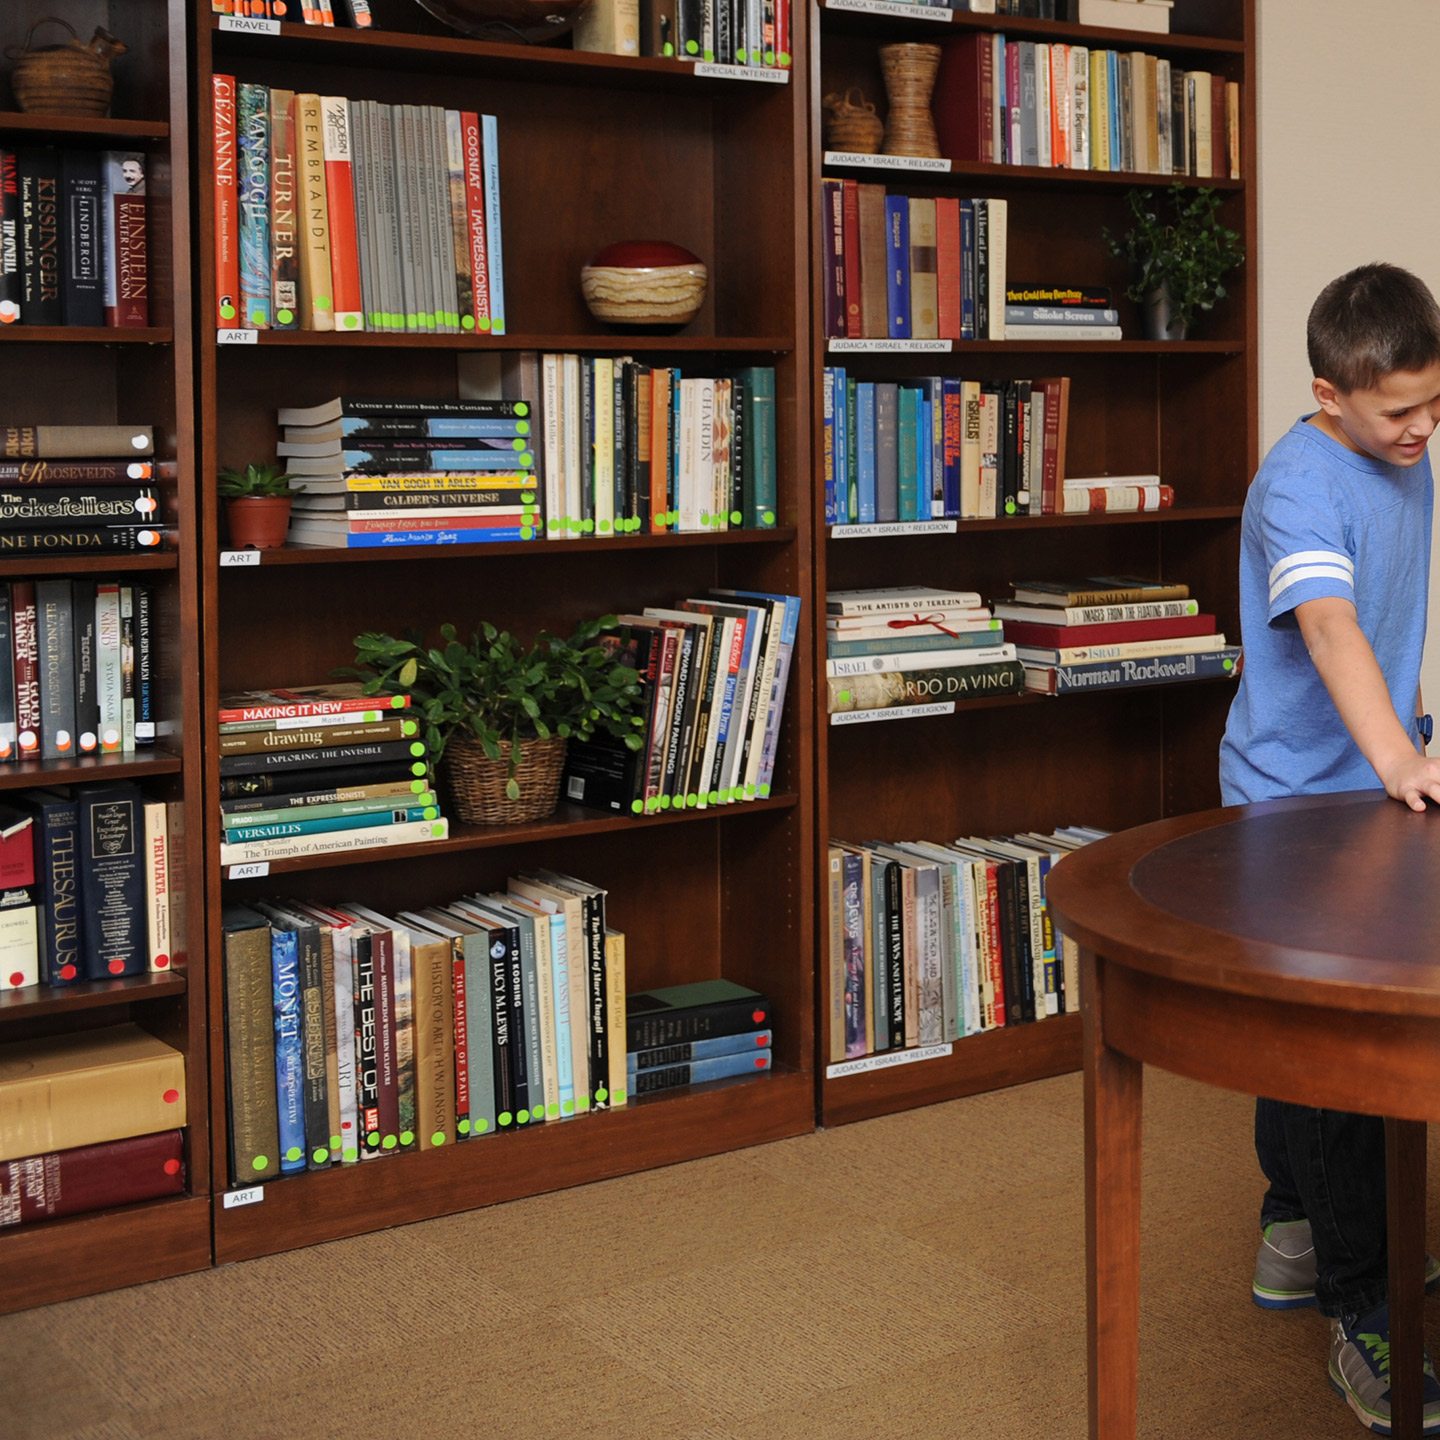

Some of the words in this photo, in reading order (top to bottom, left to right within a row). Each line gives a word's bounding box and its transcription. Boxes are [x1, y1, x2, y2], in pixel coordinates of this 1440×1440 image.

[228, 18, 272, 31] TRAVEL
[701, 65, 737, 77] SPECIAL
[740, 69, 782, 80] INTEREST
[214, 81, 233, 187] CÉZANNE
[249, 112, 269, 151] VAN
[336, 103, 348, 154] MODERN
[466, 125, 481, 190] COGNIAT
[831, 155, 866, 164] JUDAICA
[873, 157, 901, 167] ISRAEL
[908, 159, 946, 169] RELIGION
[249, 157, 269, 220] GOGH
[304, 108, 326, 253] REMBRANDT
[274, 154, 294, 261] TURNER
[118, 203, 130, 244] WALTER
[38, 178, 58, 301] KISSINGER
[79, 200, 91, 275] LINDBERGH
[128, 203, 147, 299] EINSTEIN
[120, 246, 131, 300] ISAACSON
[1033, 310, 1064, 320] Smoke
[1065, 311, 1095, 321] Screen
[226, 333, 249, 341] ART
[824, 373, 834, 419] Masada
[701, 387, 712, 462] CHARDIN
[734, 395, 742, 491] SUCCULENTS
[379, 479, 400, 489] VAN
[403, 479, 430, 489] GOGH
[433, 478, 444, 488] IN
[447, 478, 478, 488] ARLES
[0, 497, 136, 518] ockefellers
[1, 494, 23, 504] The
[383, 494, 440, 505] CALDER'S
[441, 493, 500, 504] UNIVERSE
[33, 533, 102, 547] FONDA
[878, 526, 906, 534] ISRAEL
[913, 524, 949, 532] RELIGION
[229, 554, 252, 563] ART
[876, 602, 910, 610] ARTISTS
[926, 598, 961, 607] TEREZIN
[1074, 592, 1130, 604] JERUSALEM
[46, 602, 57, 652] ELEANOR
[1083, 608, 1105, 622] IMAGES
[1106, 607, 1124, 621] FROM
[1125, 606, 1136, 619] THE
[1136, 605, 1163, 618] FLOATING
[14, 611, 28, 660] BAKER
[100, 611, 110, 647] MIND
[679, 639, 693, 681] HOWARD
[1088, 647, 1123, 660] ISRAEL
[105, 662, 114, 692] SYLVIA
[833, 660, 869, 676] ISRAEL
[1057, 667, 1121, 689] Norman
[1121, 655, 1196, 681] Rockwell
[47, 655, 62, 717] ROOSEVELT
[724, 676, 737, 701] Paint
[946, 677, 969, 693] DA
[969, 671, 1014, 689] VINCI
[17, 681, 31, 729] TIMES
[29, 680, 41, 727] GOOD
[106, 694, 115, 724] NASAR
[243, 705, 298, 721] MAKING
[298, 703, 311, 716] IT
[311, 702, 342, 715] NEW
[673, 681, 686, 726] HODGKIN
[836, 713, 870, 722] JUDAICA
[876, 709, 904, 718] ISRAEL
[911, 704, 948, 715] RELIGION
[321, 715, 346, 724] Monet
[718, 711, 731, 735] Draw
[263, 729, 324, 747] drawing
[666, 726, 681, 775] PAINTINGS
[266, 752, 319, 764] EXPLORING
[321, 749, 338, 759] THE
[340, 746, 383, 758] INVISIBLE
[289, 797, 304, 806] THE
[306, 790, 366, 804] EXPRESSIONISTS
[237, 825, 302, 840] VERSAILLES
[244, 850, 262, 860] The
[263, 846, 299, 860] Triumph
[300, 844, 310, 854] of
[311, 840, 353, 853] American
[354, 836, 388, 850] Painting
[153, 835, 166, 896] TRIVIATA
[238, 865, 261, 876] ART
[52, 829, 79, 965] THESAURUS
[592, 916, 602, 932] The
[891, 914, 900, 932] THE
[511, 949, 520, 962] DE
[592, 932, 603, 959] World
[891, 933, 901, 960] JEWS
[493, 962, 506, 993] LUCY
[591, 960, 602, 971] of
[892, 961, 901, 981] AND
[360, 961, 375, 1002] THE
[431, 961, 444, 1007] HISTORY
[455, 973, 464, 995] THE
[512, 963, 522, 1007] KOONING
[594, 971, 603, 996] Marc
[278, 962, 298, 1041] MONET
[495, 994, 506, 1010] M.
[893, 982, 903, 1025] EUROPE
[432, 1009, 444, 1023] OF
[457, 1000, 466, 1046] MAJESTY
[495, 1011, 509, 1045] LEWIS
[592, 997, 604, 1034] Chagall
[361, 1007, 377, 1064] BEST
[432, 1024, 445, 1045] ART
[458, 1051, 466, 1064] OF
[833, 1062, 868, 1075] JUDAICA
[874, 1055, 903, 1067] ISRAEL
[909, 1046, 947, 1059] RELIGION
[338, 1058, 353, 1092] ART
[364, 1070, 377, 1099] OF
[458, 1070, 467, 1102] SPAIN
[366, 1108, 378, 1131] LIFE
[232, 1191, 255, 1203] ART
